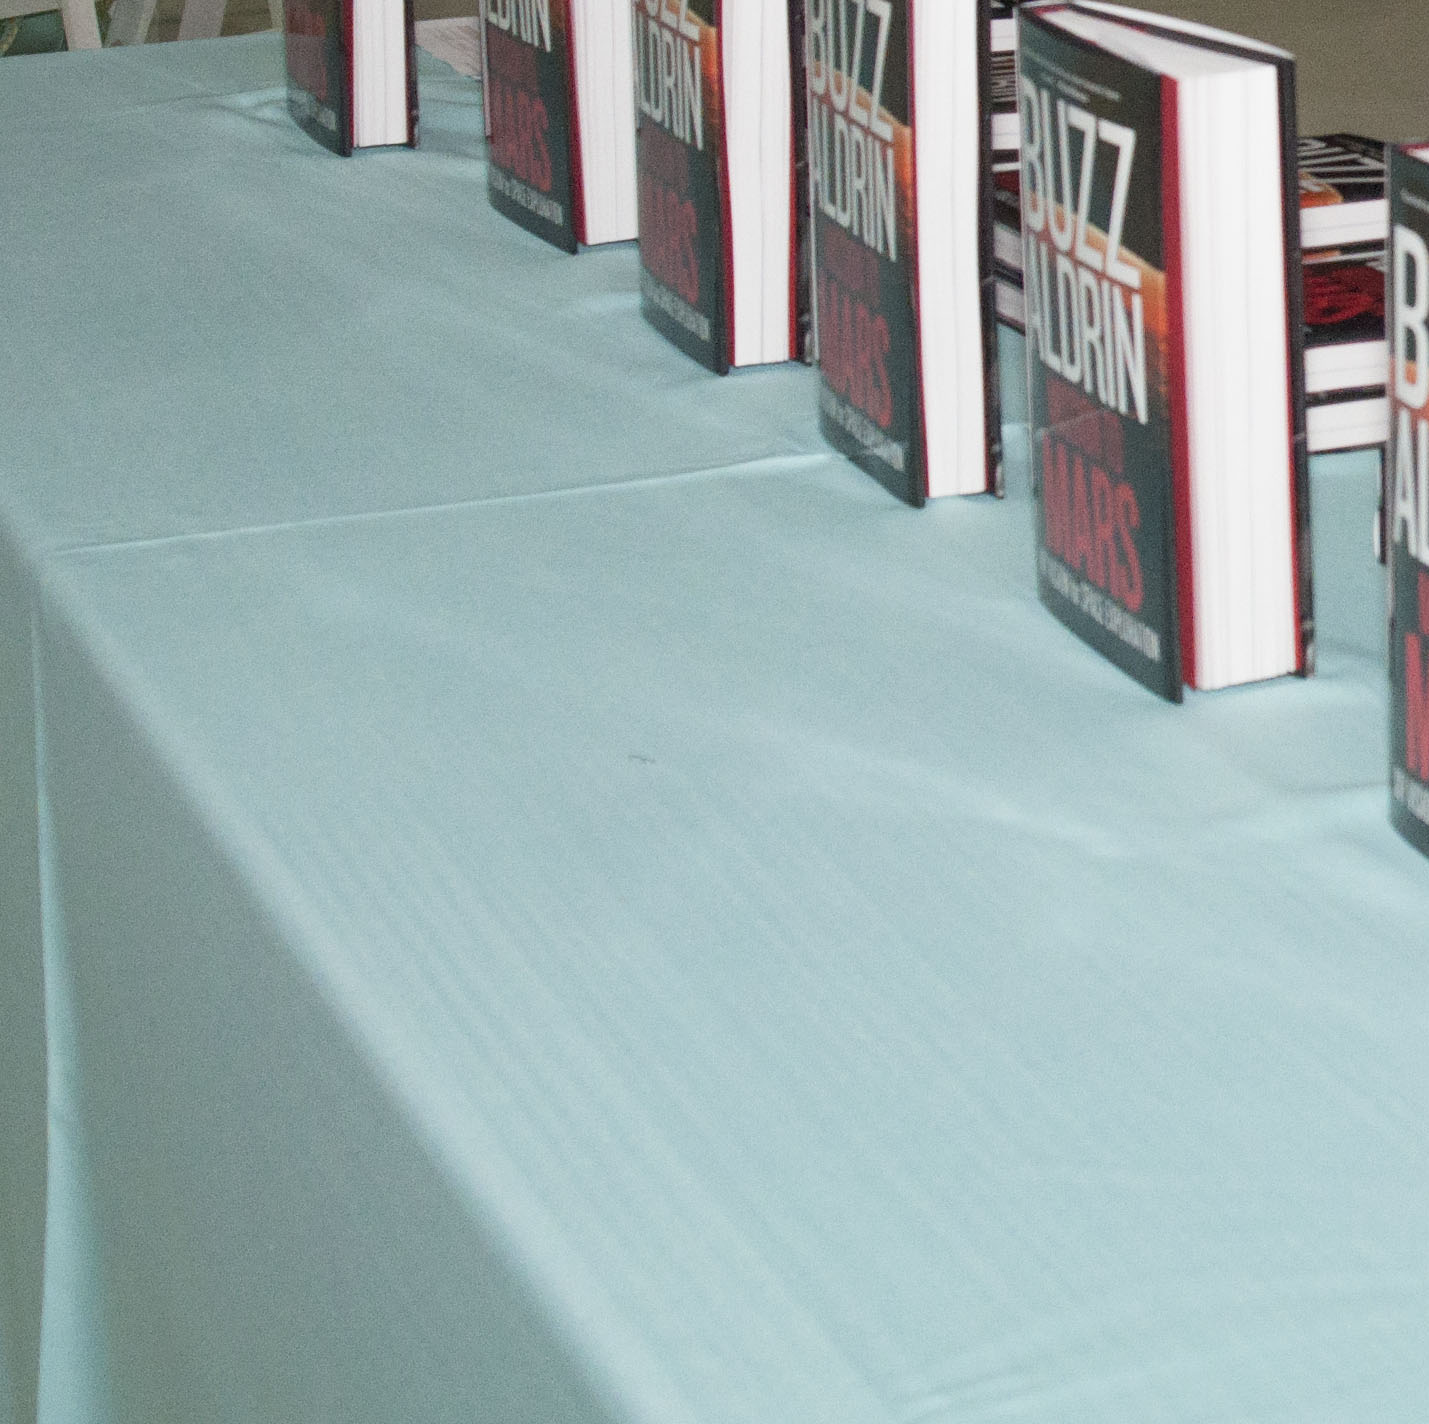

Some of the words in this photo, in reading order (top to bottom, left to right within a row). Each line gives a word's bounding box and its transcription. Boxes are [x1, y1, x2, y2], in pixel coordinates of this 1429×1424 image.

[635, 11, 704, 152] LDRIN
[809, 95, 898, 264] ALDRIN
[1018, 76, 1142, 290] BUZZ
[1026, 232, 1150, 427] ALDRIN
[1041, 430, 1145, 614] MARS
